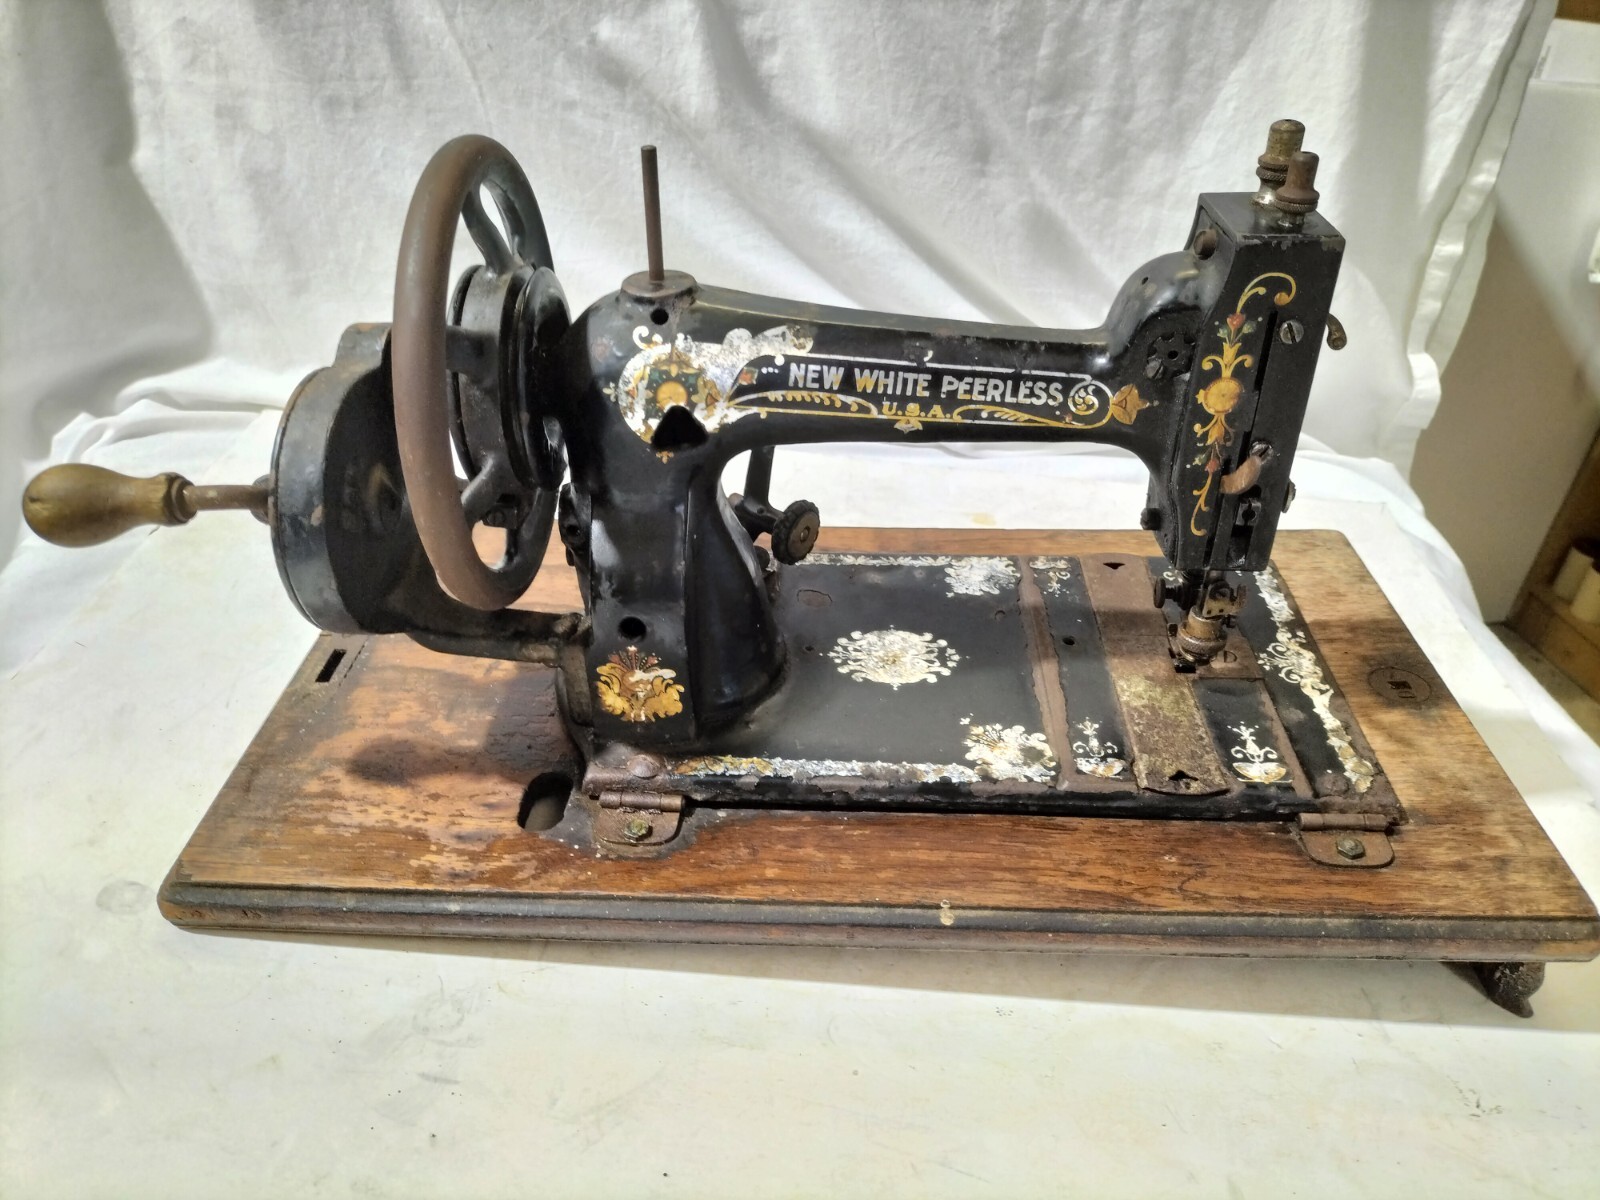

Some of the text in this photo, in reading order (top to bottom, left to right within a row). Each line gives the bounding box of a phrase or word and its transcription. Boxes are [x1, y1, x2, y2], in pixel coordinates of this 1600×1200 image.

[788, 362, 1064, 407] NEW WHITE PEERLESS
[881, 401, 951, 419] U.S.A.
